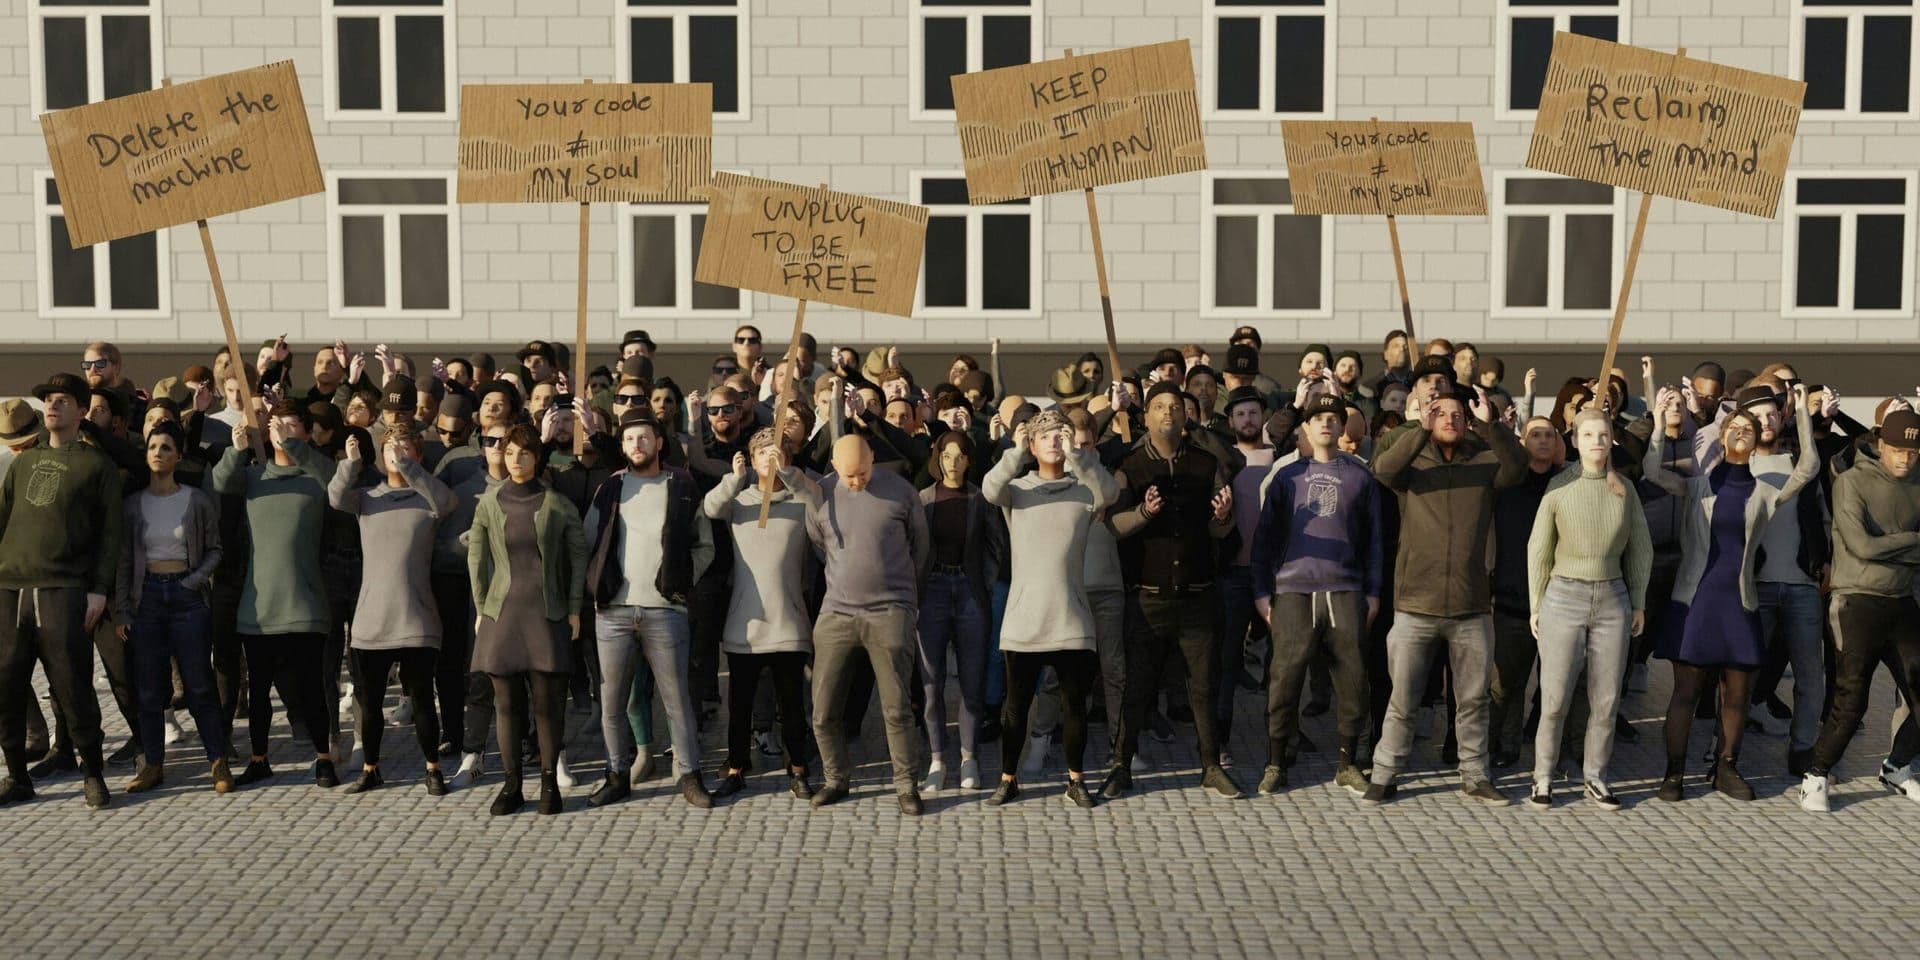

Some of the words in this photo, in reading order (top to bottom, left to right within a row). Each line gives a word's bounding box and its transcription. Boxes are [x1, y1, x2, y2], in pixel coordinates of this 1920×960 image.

[594, 91, 652, 115] code
[1031, 67, 1107, 108] KEEP
[1586, 83, 1727, 128] Reclaim
[87, 110, 198, 168] Delete
[220, 91, 280, 125] the
[1053, 104, 1095, 139] IT
[1386, 127, 1430, 146] code
[1046, 127, 1154, 180] HUMAN
[1674, 138, 1759, 175] mind
[132, 147, 251, 204] machine
[763, 196, 866, 238] UNPLUG
[752, 231, 796, 254] TO
[811, 234, 845, 259] BE
[782, 262, 876, 294] FREE
